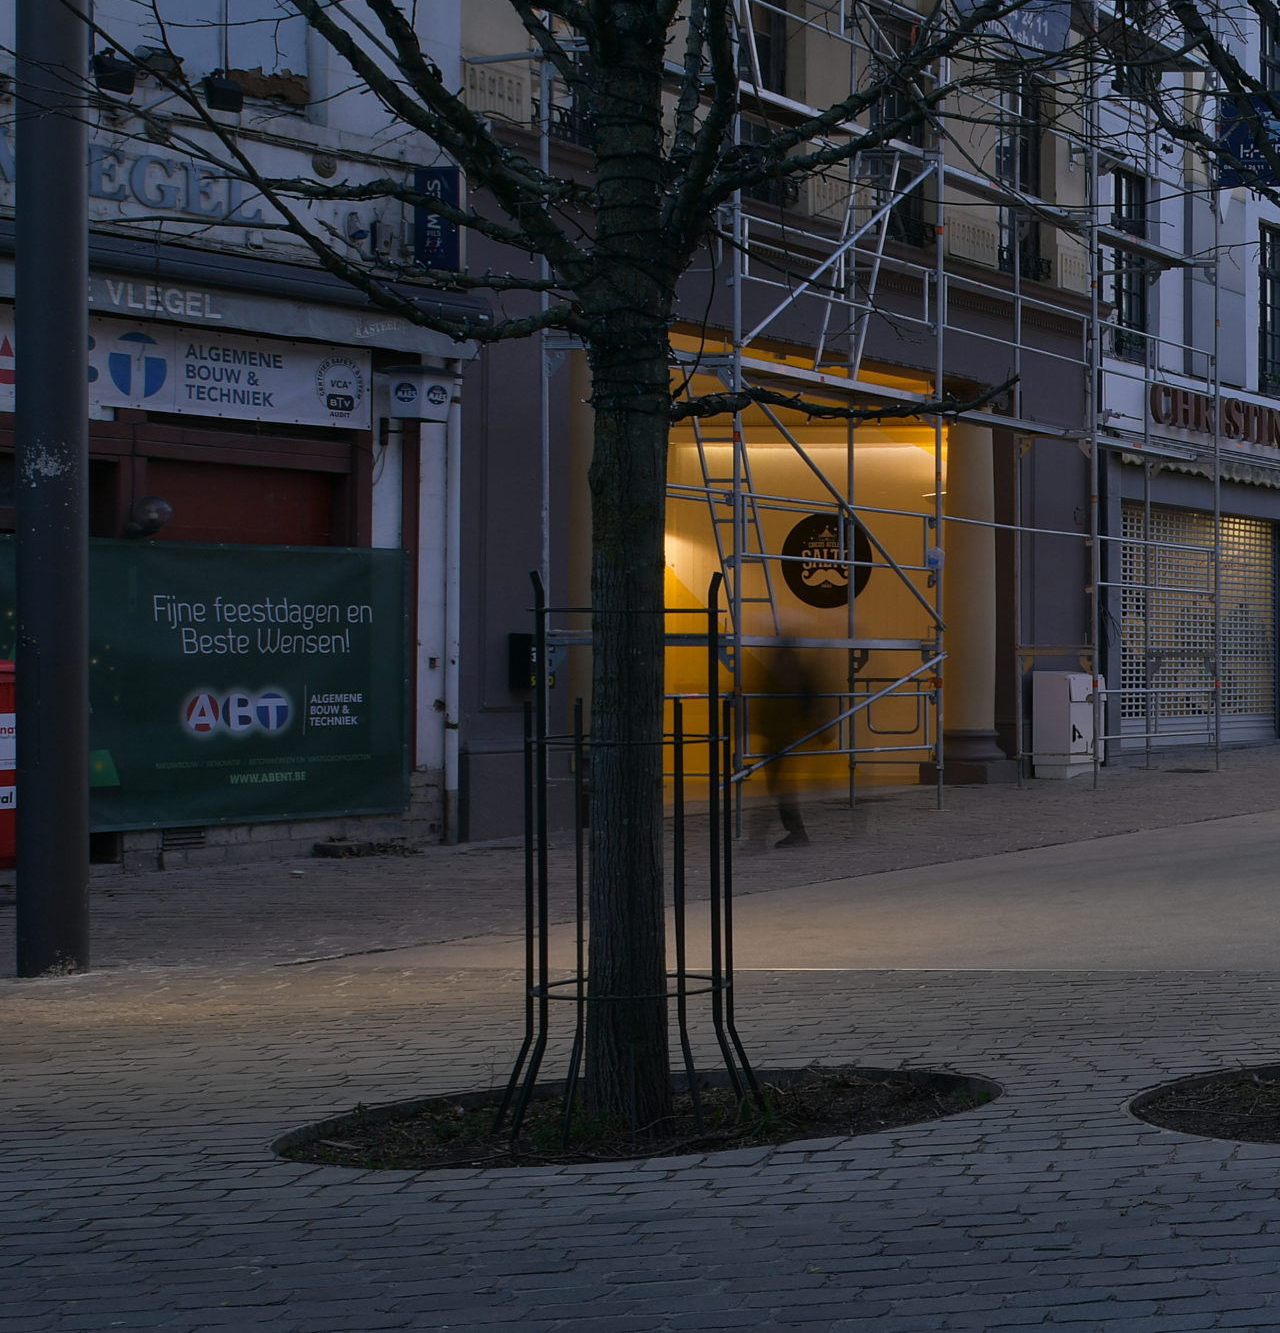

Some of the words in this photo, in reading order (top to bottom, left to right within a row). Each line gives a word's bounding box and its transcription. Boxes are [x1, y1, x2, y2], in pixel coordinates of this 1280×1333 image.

[106, 278, 222, 319] VLEGEL
[185, 343, 283, 370] ALGEMENE
[185, 364, 244, 386] BOUW
[247, 370, 259, 386] &
[185, 384, 274, 408] TECHNIEK
[153, 595, 206, 629] Fijne
[213, 597, 340, 630] feestdagen
[346, 604, 374, 623] en
[182, 628, 250, 654] Beste
[257, 628, 351, 654] Wensen!
[310, 693, 363, 704] ALGEMENE
[310, 705, 341, 716] BOUW
[342, 705, 350, 715] &
[187, 692, 289, 733] ABT
[309, 716, 358, 727] TECHNIEK
[229, 770, 307, 785] WWW.ABENT.BE
